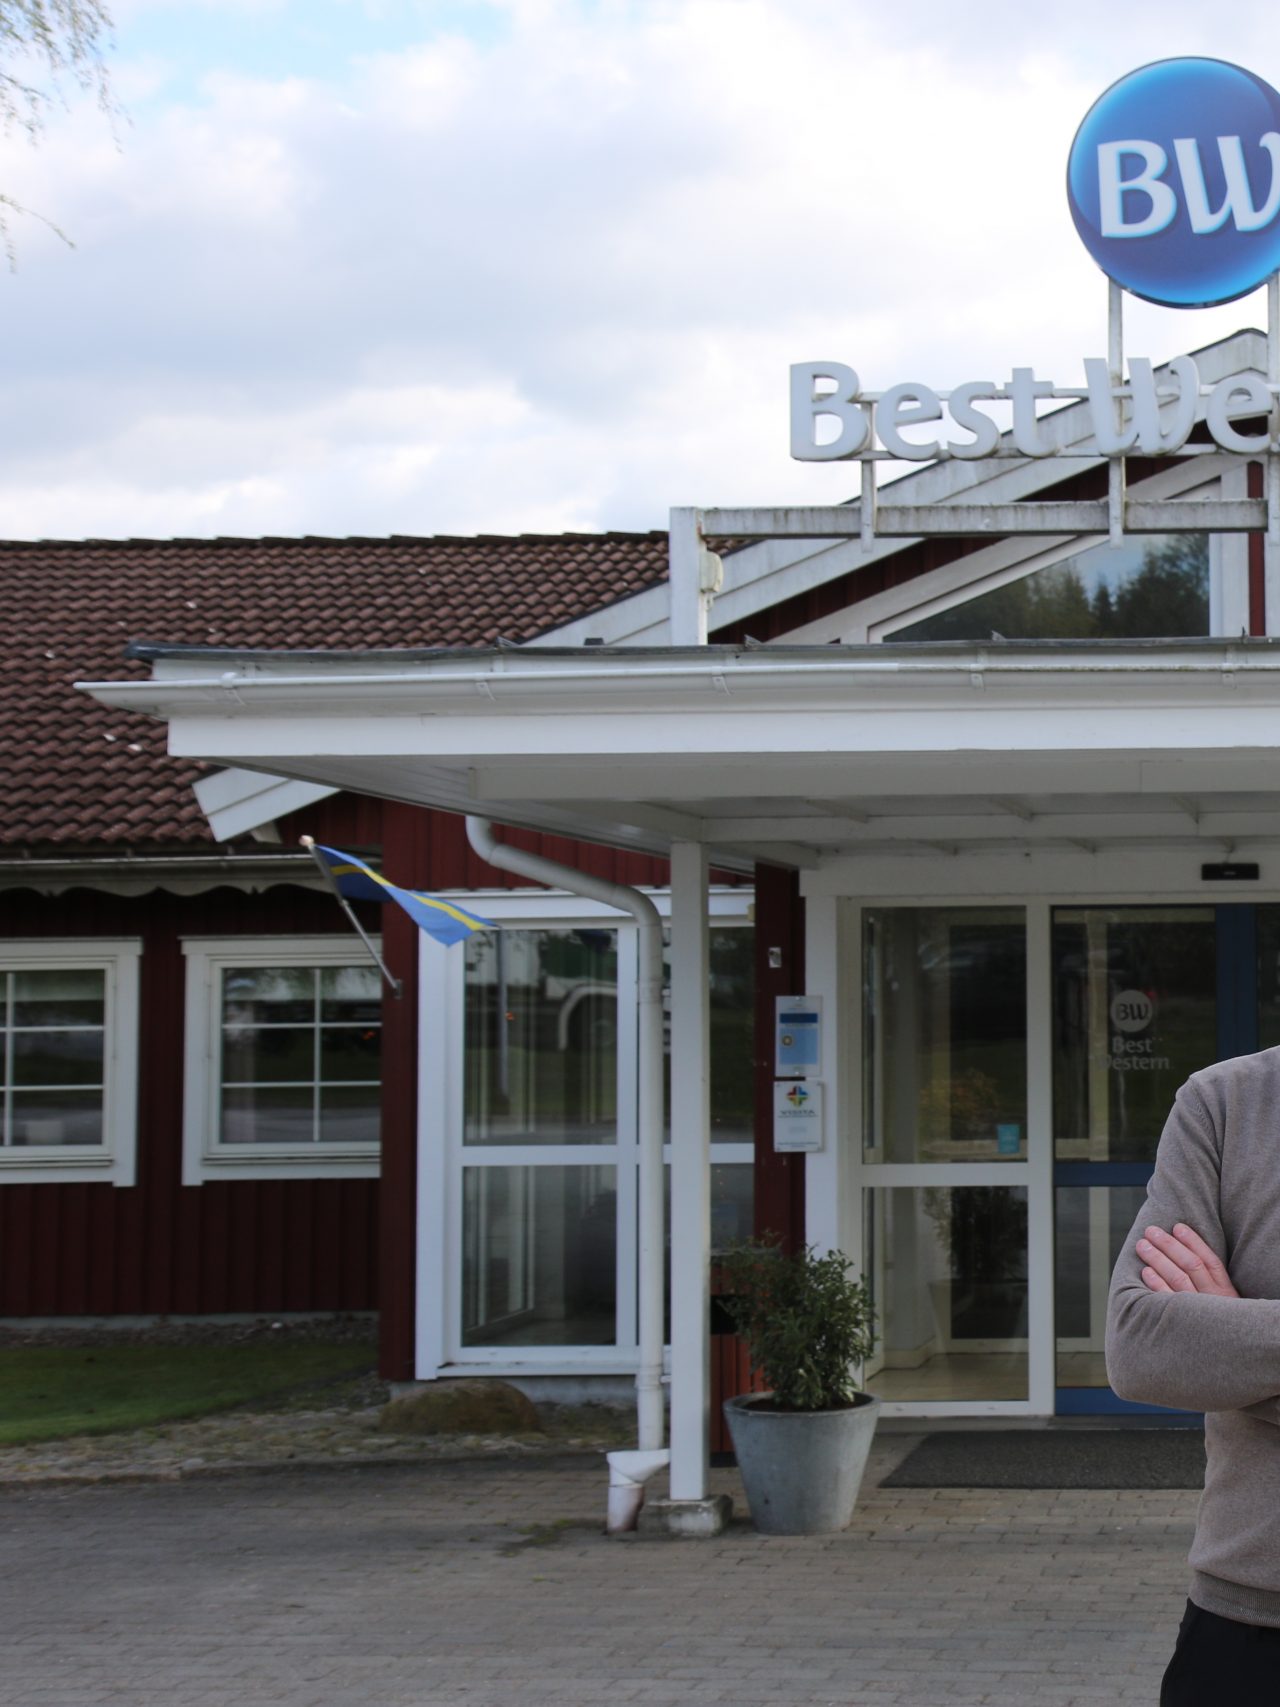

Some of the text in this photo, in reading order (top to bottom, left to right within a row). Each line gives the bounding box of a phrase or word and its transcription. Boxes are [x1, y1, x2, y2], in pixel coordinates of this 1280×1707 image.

[789, 361, 1060, 462] Best
[1115, 1003, 1150, 1021] BW
[1112, 1036, 1152, 1053] Best
